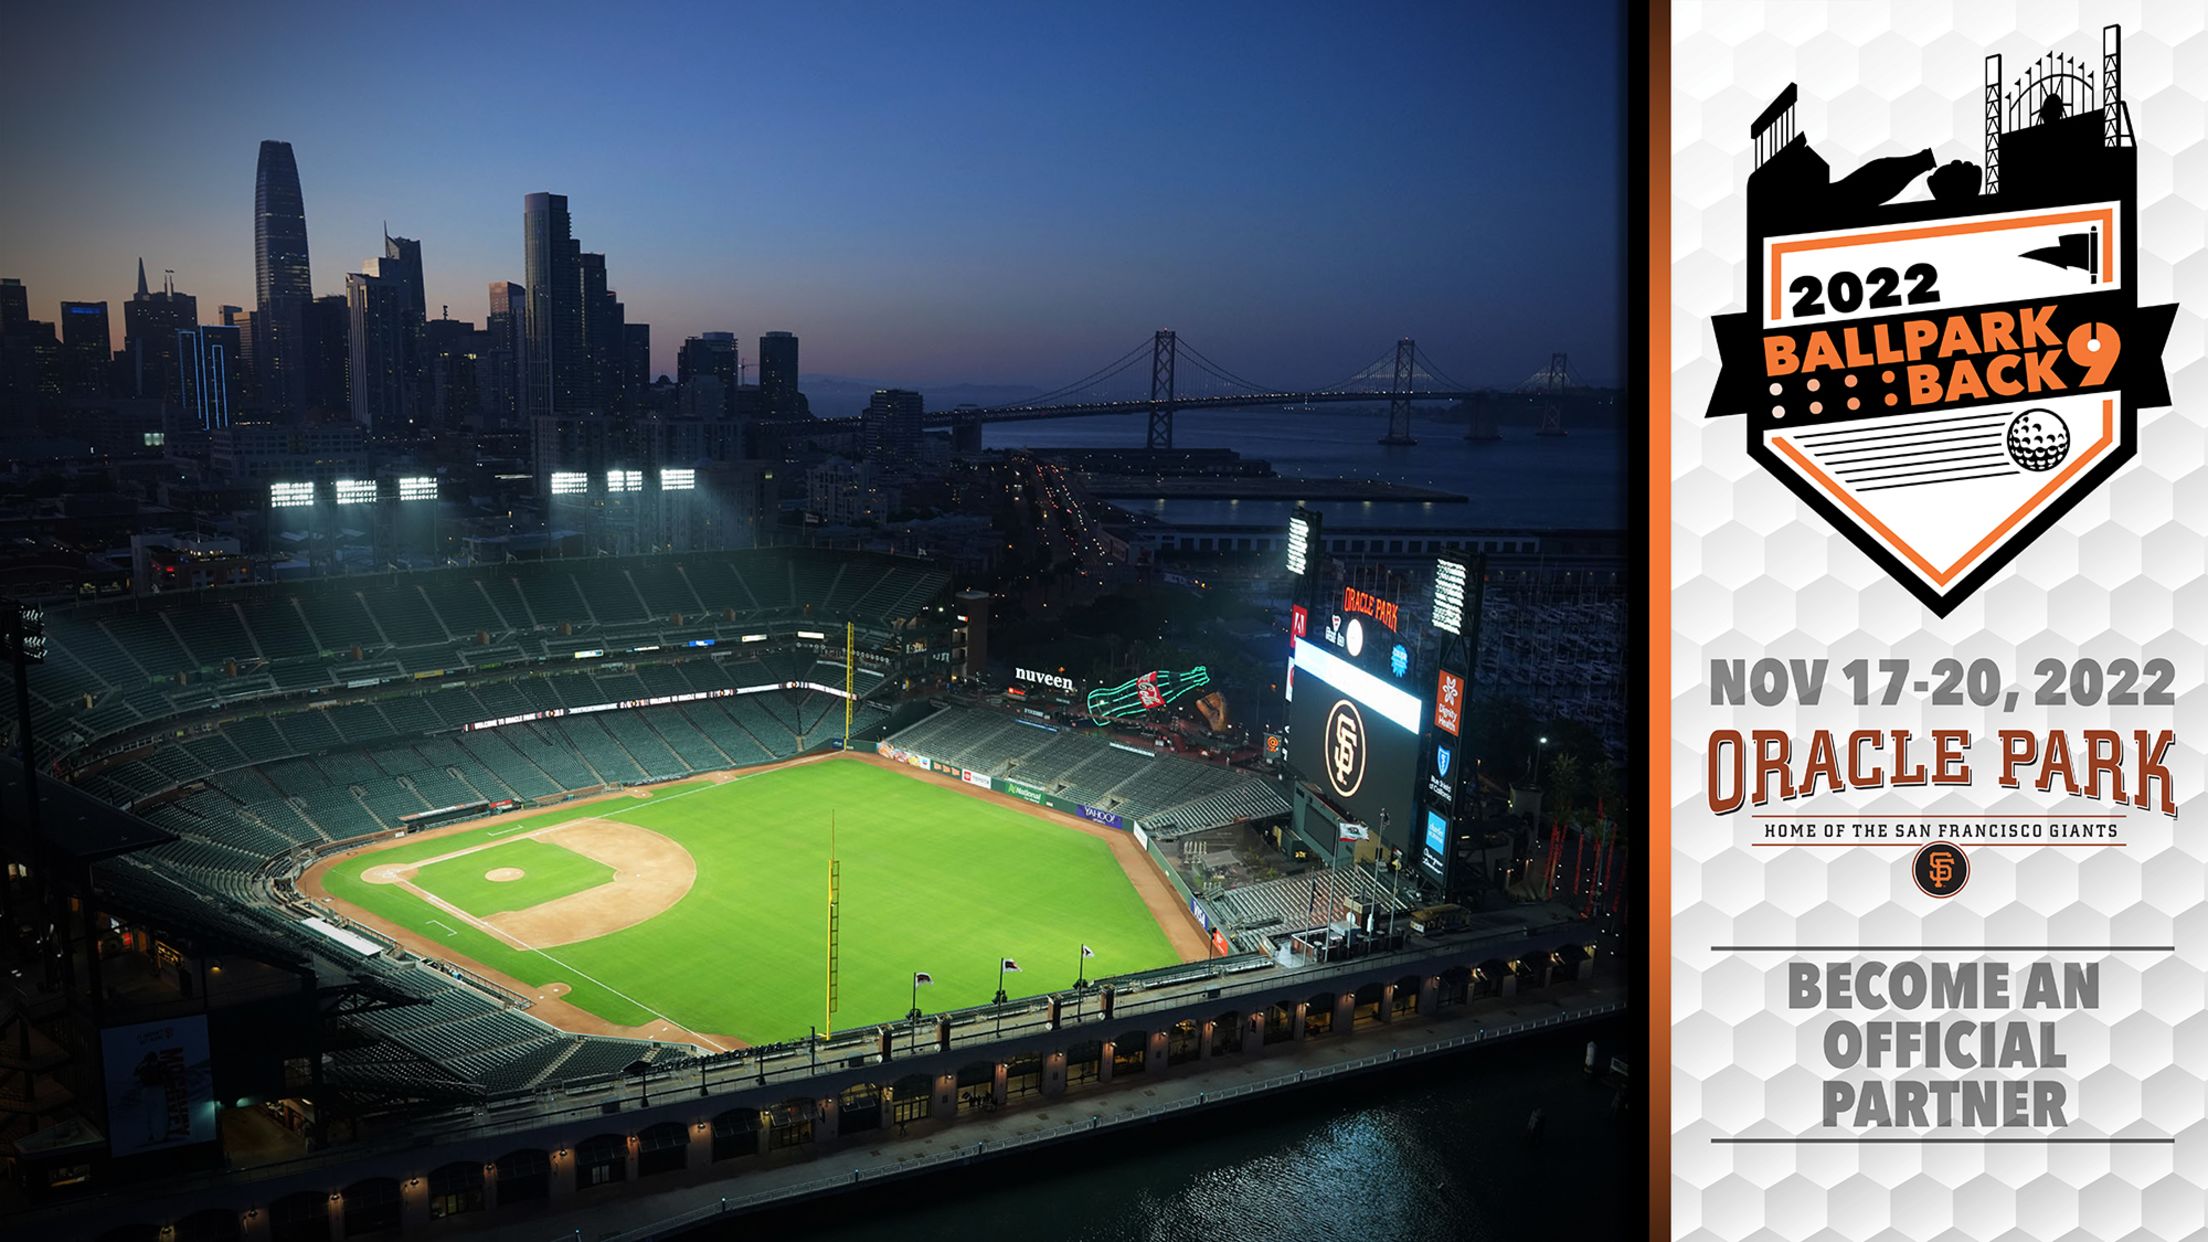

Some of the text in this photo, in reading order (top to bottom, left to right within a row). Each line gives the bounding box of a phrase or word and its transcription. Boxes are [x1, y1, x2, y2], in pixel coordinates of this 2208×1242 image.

[1344, 586, 1375, 616] ORACLE
[1375, 598, 1399, 633] PARK
[1015, 667, 1074, 690] nuveen
